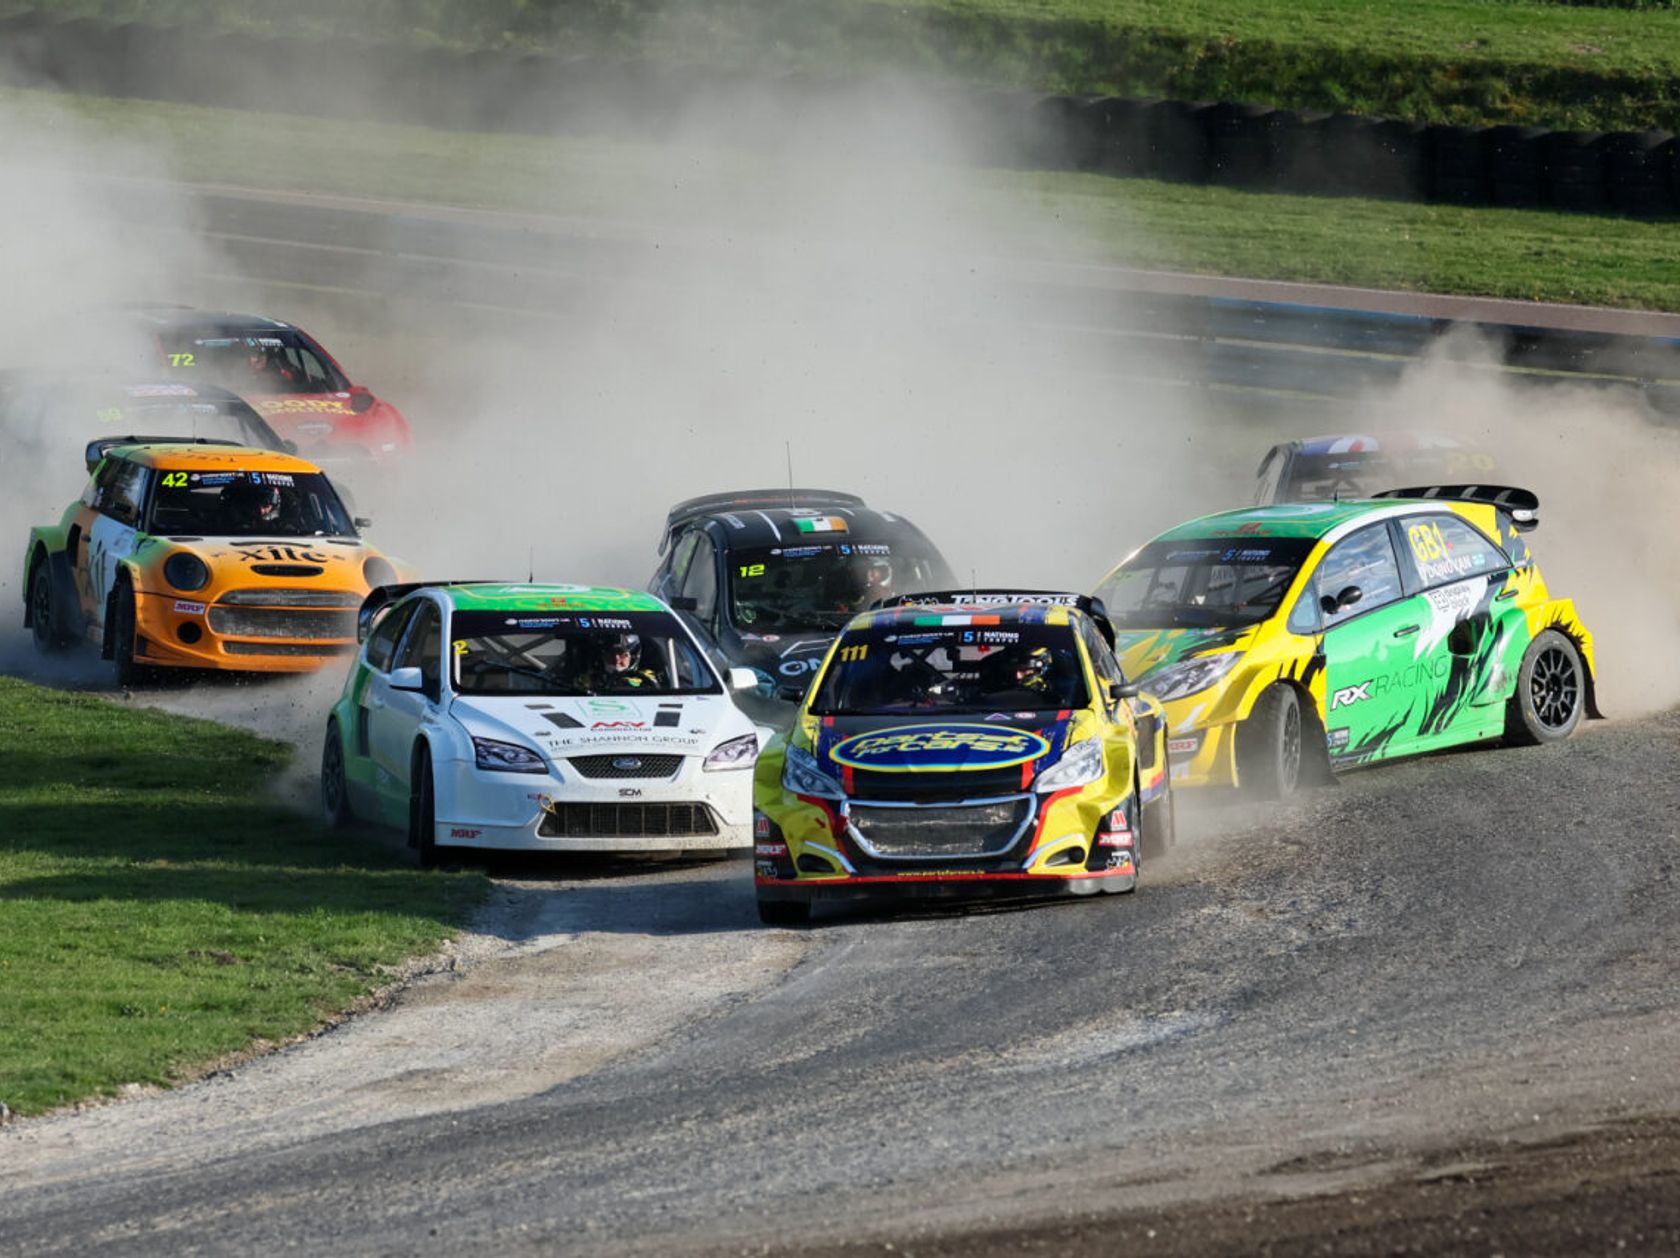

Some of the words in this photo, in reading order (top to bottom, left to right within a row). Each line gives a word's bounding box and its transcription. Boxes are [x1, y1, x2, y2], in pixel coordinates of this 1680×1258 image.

[168, 353, 195, 366] 72
[162, 472, 188, 487] 42
[252, 473, 260, 484] 5
[1408, 522, 1450, 561] GB1
[840, 545, 850, 555] 5
[739, 564, 765, 577] 12
[579, 617, 590, 628] 5
[963, 631, 975, 643] 5
[984, 631, 1020, 639] NATIONS
[453, 640, 468, 655] 2
[839, 644, 869, 662] 111
[1330, 679, 1374, 712] RX
[1374, 655, 1448, 697] RACING
[548, 739, 573, 747] THE
[580, 736, 648, 744] SHANNON
[652, 736, 699, 745] GROUP
[618, 788, 642, 797] SCM
